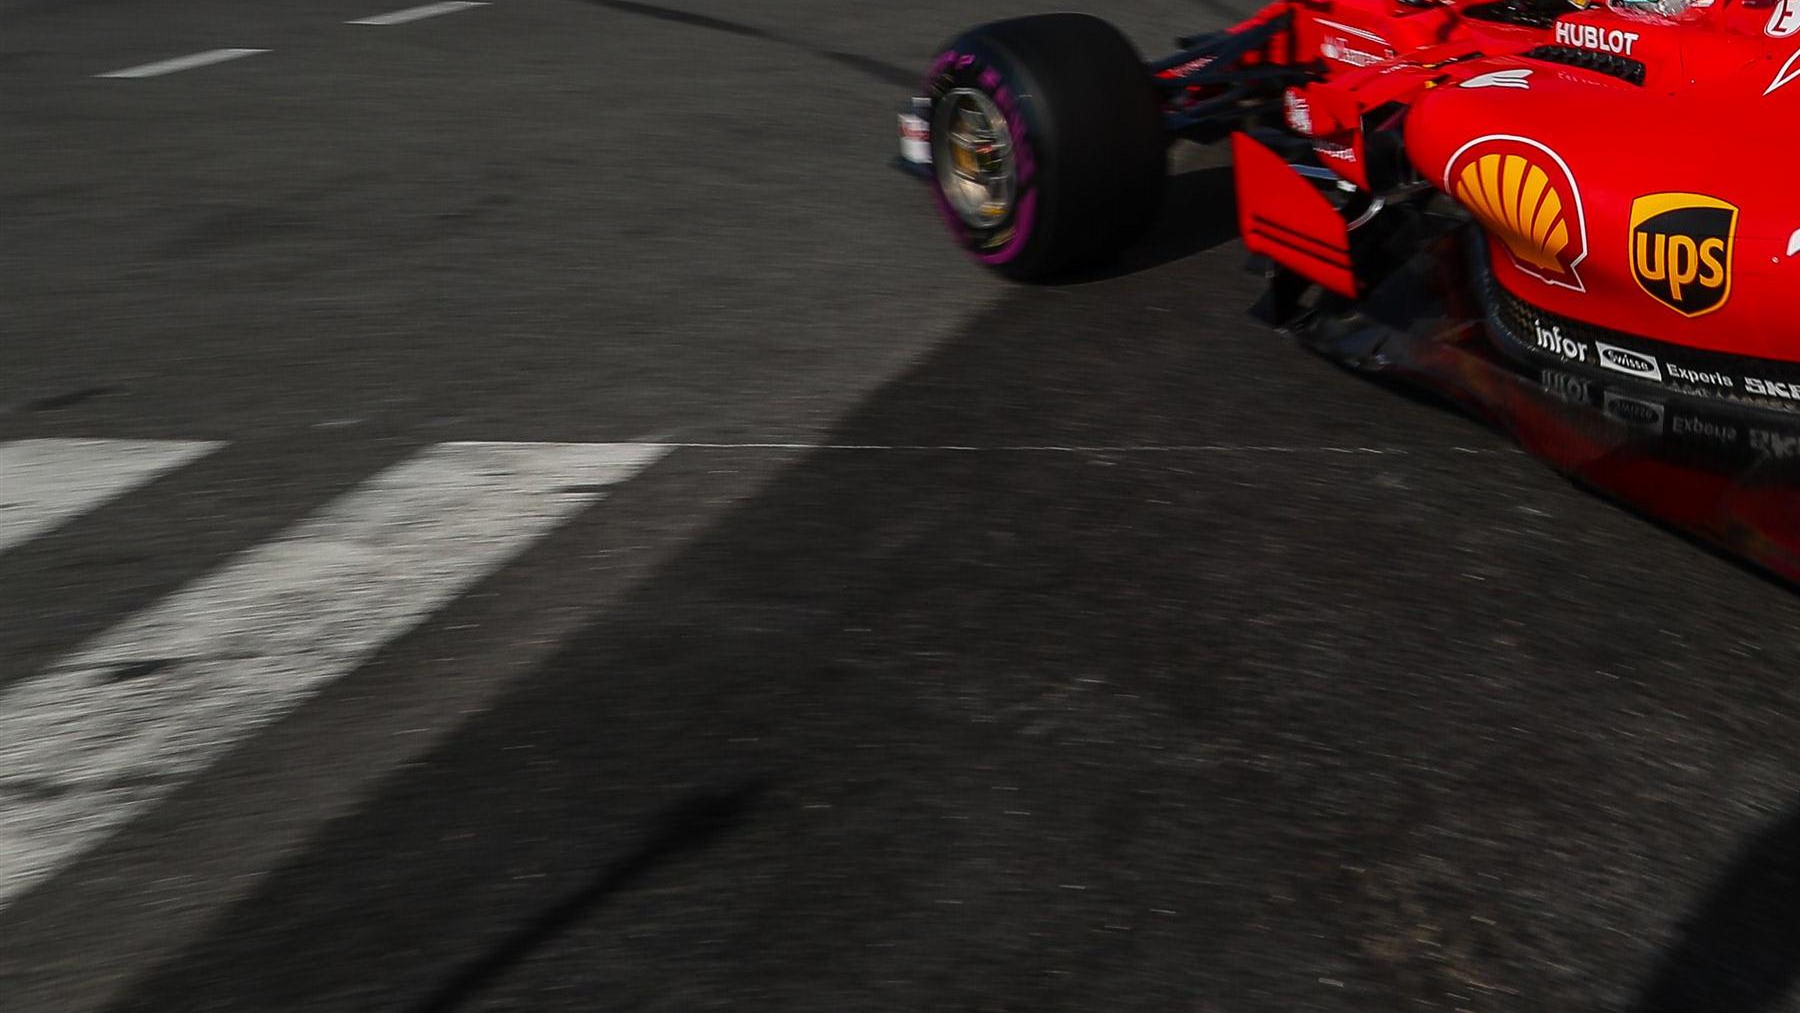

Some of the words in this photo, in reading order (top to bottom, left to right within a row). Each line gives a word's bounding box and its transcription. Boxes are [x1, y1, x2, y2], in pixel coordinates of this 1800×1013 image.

[1555, 21, 1639, 56] HUBLOT
[1636, 231, 1725, 301] ups
[1534, 319, 1588, 362] infor
